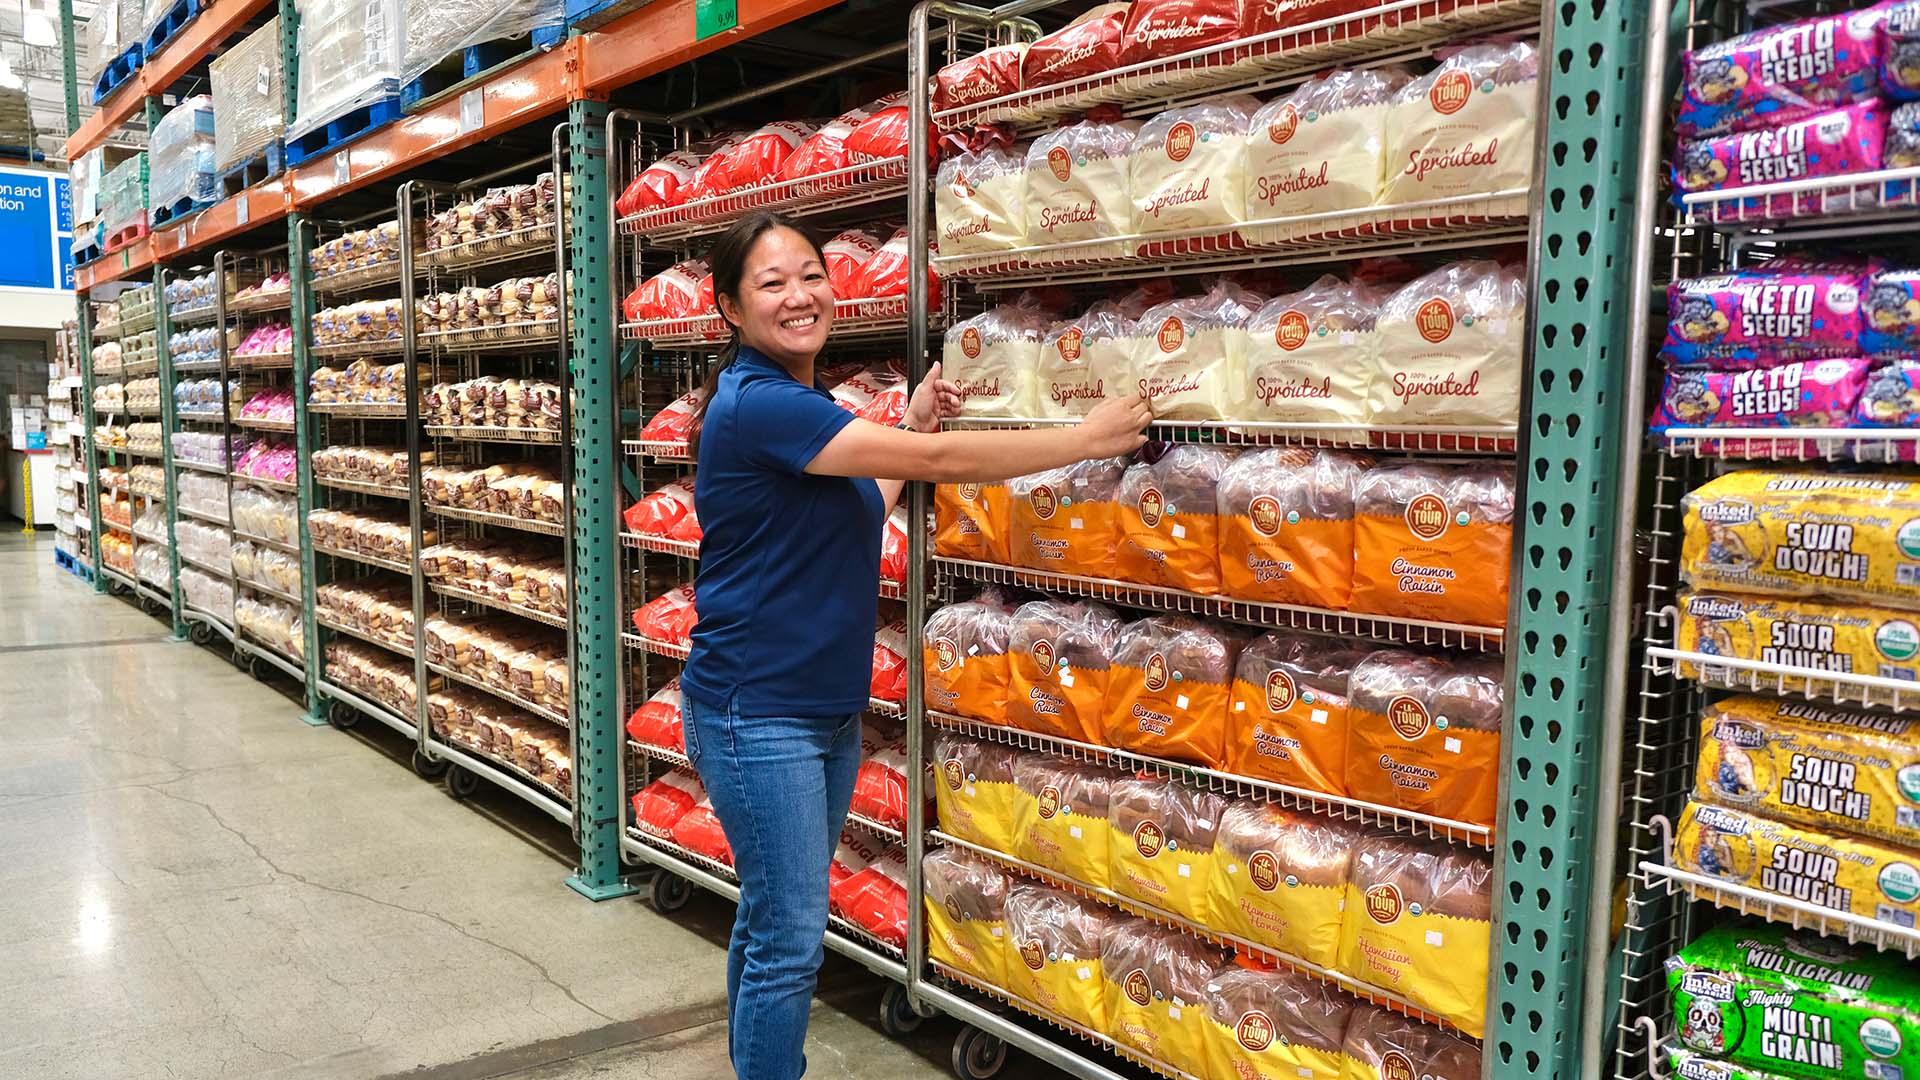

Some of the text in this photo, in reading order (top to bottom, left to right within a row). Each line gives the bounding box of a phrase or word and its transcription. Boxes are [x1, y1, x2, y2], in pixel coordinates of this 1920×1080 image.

[1136, 14, 1205, 49] Sprouted
[1760, 19, 1834, 64] KETO
[949, 75, 1000, 104] Sprouted
[1437, 83, 1466, 103] TOUR
[1170, 136, 1190, 150] TOUR
[1740, 124, 1807, 162] KETO
[1405, 138, 1498, 182] Sprouted
[15, 186, 41, 198] and
[1258, 161, 1328, 206] Sprouted
[1145, 177, 1209, 217] Sprouted
[1040, 199, 1097, 232] Sprouted
[1742, 284, 1815, 315] KETO
[1429, 306, 1440, 315] LA
[1281, 325, 1304, 340] TOUR
[1421, 314, 1448, 332] TOUR
[1163, 330, 1181, 344] TOUR
[1392, 370, 1479, 405] Sprouted
[1733, 362, 1804, 394] KETO
[954, 378, 1000, 403] Sprouted
[1051, 379, 1106, 407] Sprouted
[1256, 376, 1331, 406] Sprouted
[1035, 496, 1051, 508] TOUR
[1142, 502, 1159, 516] TOUR
[1423, 501, 1432, 511] LA
[1701, 503, 1750, 516] inked
[1254, 510, 1277, 524] TOUR
[1414, 510, 1442, 526] TOUR
[1031, 533, 1069, 548] Cinnamon
[1787, 522, 1854, 552] SOUR
[1391, 557, 1456, 580] Cinnamon
[1776, 546, 1860, 581] DOUGH
[1399, 575, 1445, 594] Raisin
[1692, 600, 1740, 613] inked
[1772, 621, 1834, 652] SOUR
[1035, 652, 1050, 666] TOUR
[1270, 683, 1289, 702] TOUR
[1132, 704, 1173, 725] Cinnamon
[1403, 704, 1413, 712] LA
[1138, 718, 1166, 736] Raisin
[1395, 710, 1423, 729] TOUR
[1253, 724, 1301, 749] Cinnamon
[1717, 723, 1761, 740] inked
[1256, 741, 1291, 761] Raisin
[1379, 754, 1438, 780] Cinnamon
[1791, 754, 1856, 790] SOUR
[1391, 770, 1430, 791] Raisin
[1781, 778, 1862, 820] DOUGH
[1699, 806, 1744, 830] inked
[1139, 832, 1159, 849] TOUR
[1254, 864, 1273, 883] TOUR
[1772, 844, 1838, 885] SOUR
[1378, 888, 1387, 897] LA
[1762, 867, 1842, 910] DOUGH
[1240, 897, 1289, 929] Hawaiian
[1370, 895, 1395, 914] TOUR
[1249, 917, 1283, 939] Honey
[1359, 936, 1412, 965] Hawaiian
[1367, 956, 1401, 983] Honey
[1746, 949, 1868, 990] MULTIGRAIN
[1131, 982, 1148, 998] TOUR
[1685, 976, 1731, 993] inked
[1685, 985, 1731, 1000] ORGANICS
[1743, 990, 1794, 1008] Mighty
[1252, 1018, 1261, 1027] LA
[1764, 1007, 1832, 1042] MULTI
[1243, 1025, 1268, 1043] TOUR
[1762, 1031, 1835, 1069] GRAIN
[1387, 1064, 1410, 1080] TOUR
[1681, 1062, 1728, 1080] inked
